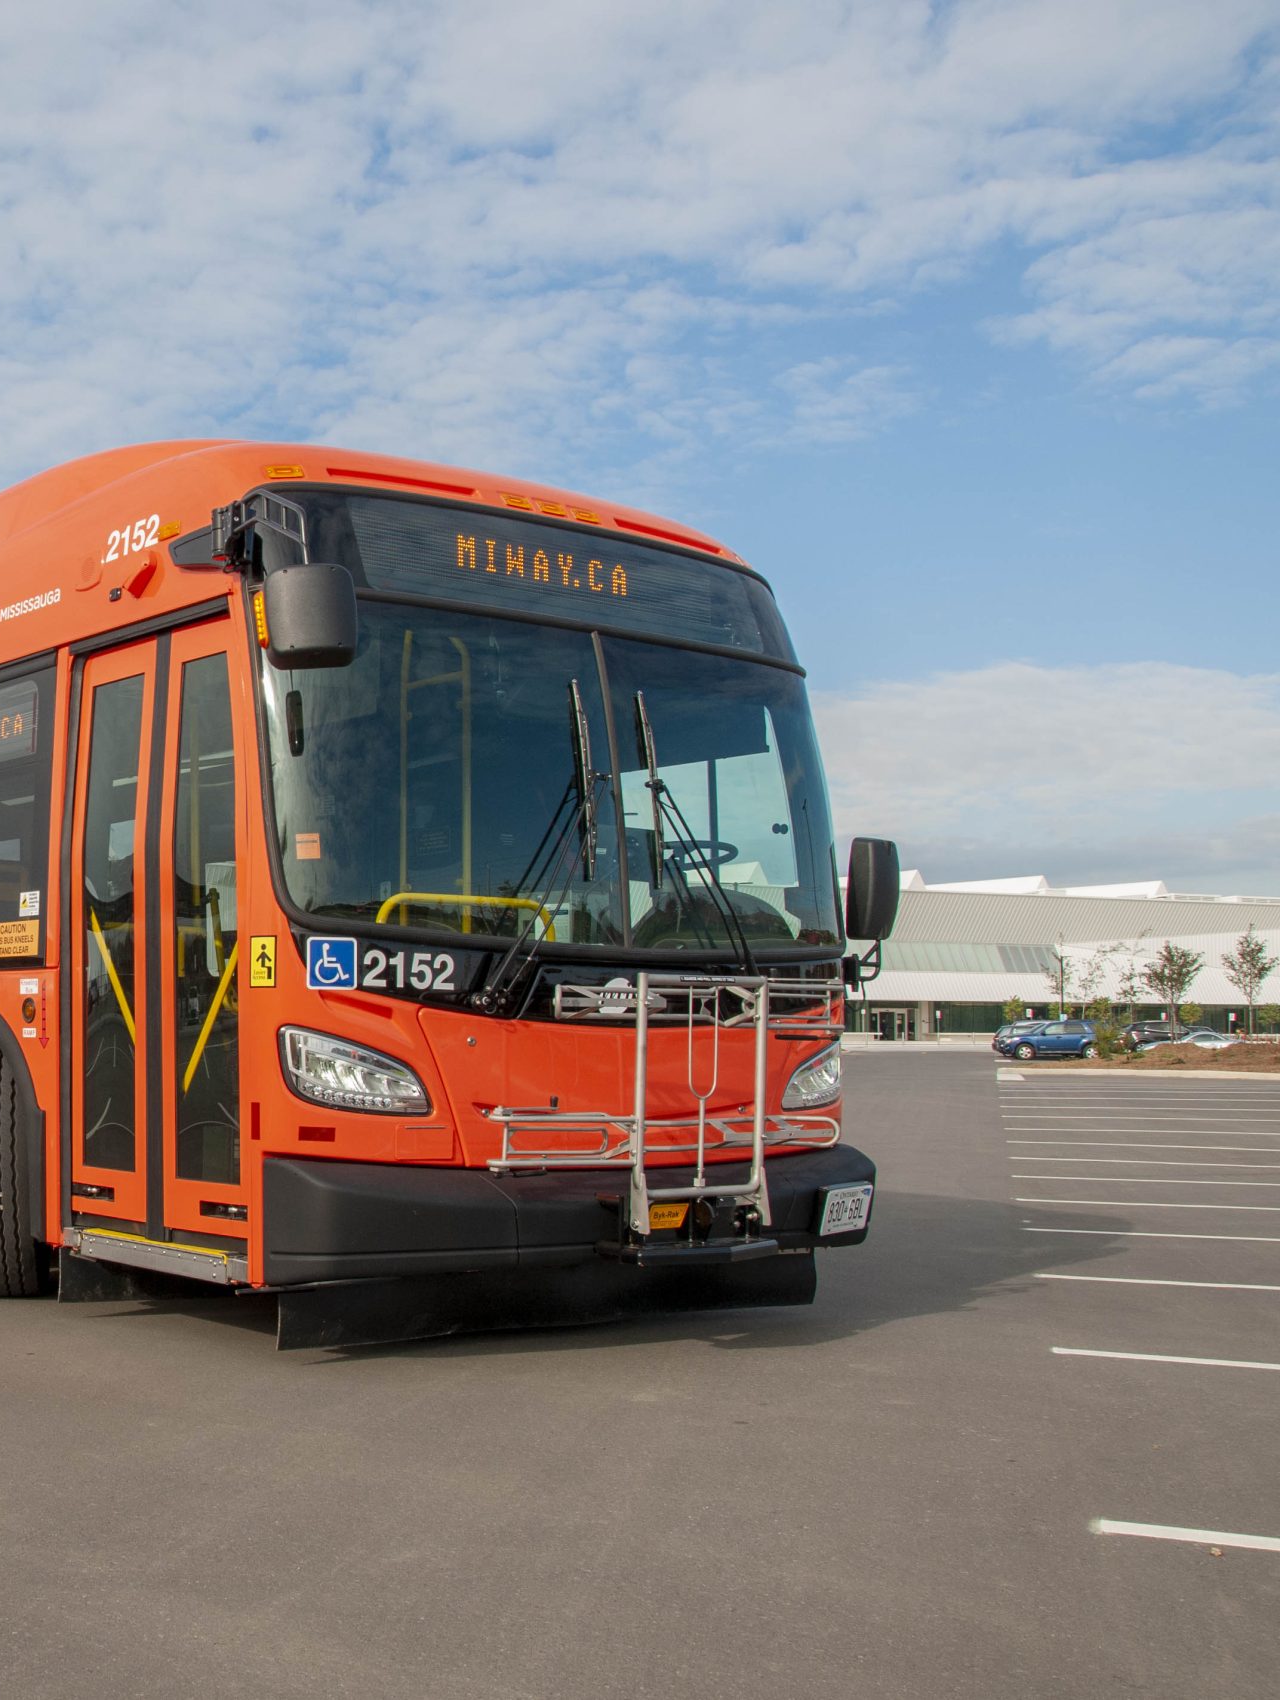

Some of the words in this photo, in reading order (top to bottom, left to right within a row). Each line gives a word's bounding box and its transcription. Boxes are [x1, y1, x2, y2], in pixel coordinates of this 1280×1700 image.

[106, 514, 160, 563] 2152
[457, 534, 628, 597] MIWAY.CA
[0, 923, 26, 935] CAUTION
[4, 936, 13, 945] BUS
[14, 934, 34, 943] KNEELS
[13, 945, 29, 954] CLEAR
[362, 949, 455, 991] 2152
[653, 1210, 680, 1221] Byk-Rak
